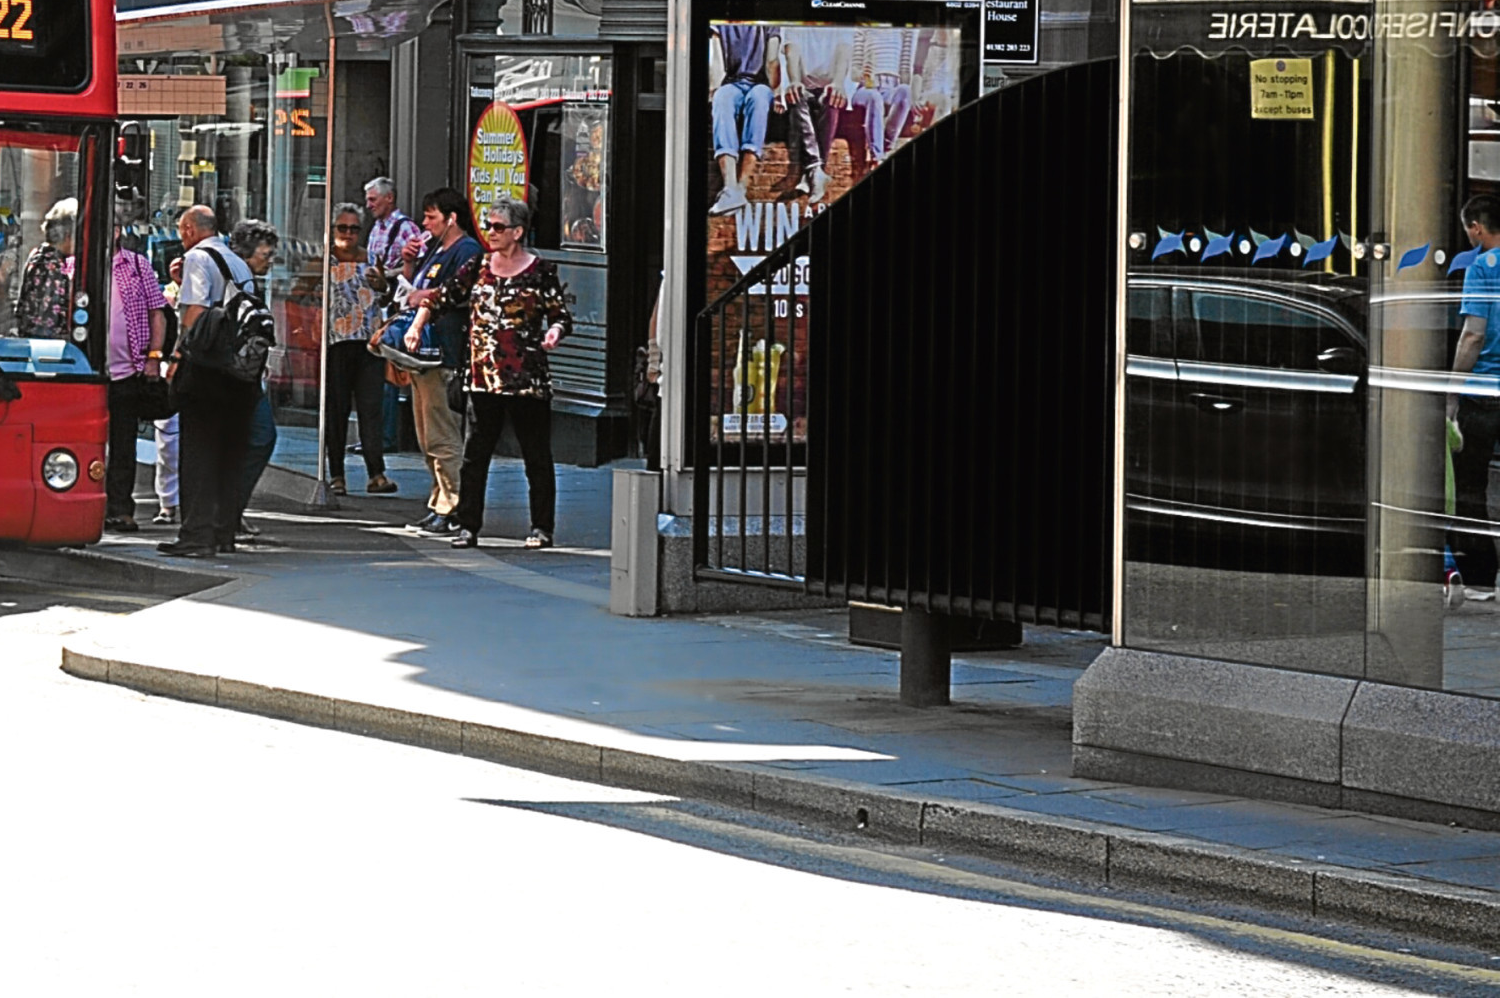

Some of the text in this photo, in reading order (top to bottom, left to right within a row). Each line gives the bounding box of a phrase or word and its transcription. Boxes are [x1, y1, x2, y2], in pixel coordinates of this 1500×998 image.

[985, 0, 1028, 10] estaurant
[987, 10, 1018, 22] House
[1255, 74, 1308, 86] No stopping
[1286, 105, 1311, 115] buses
[476, 128, 516, 145] Summer
[483, 146, 524, 166] Holidays
[469, 167, 526, 185] Kids All You
[473, 186, 493, 203] Can
[735, 202, 800, 252] WIN
